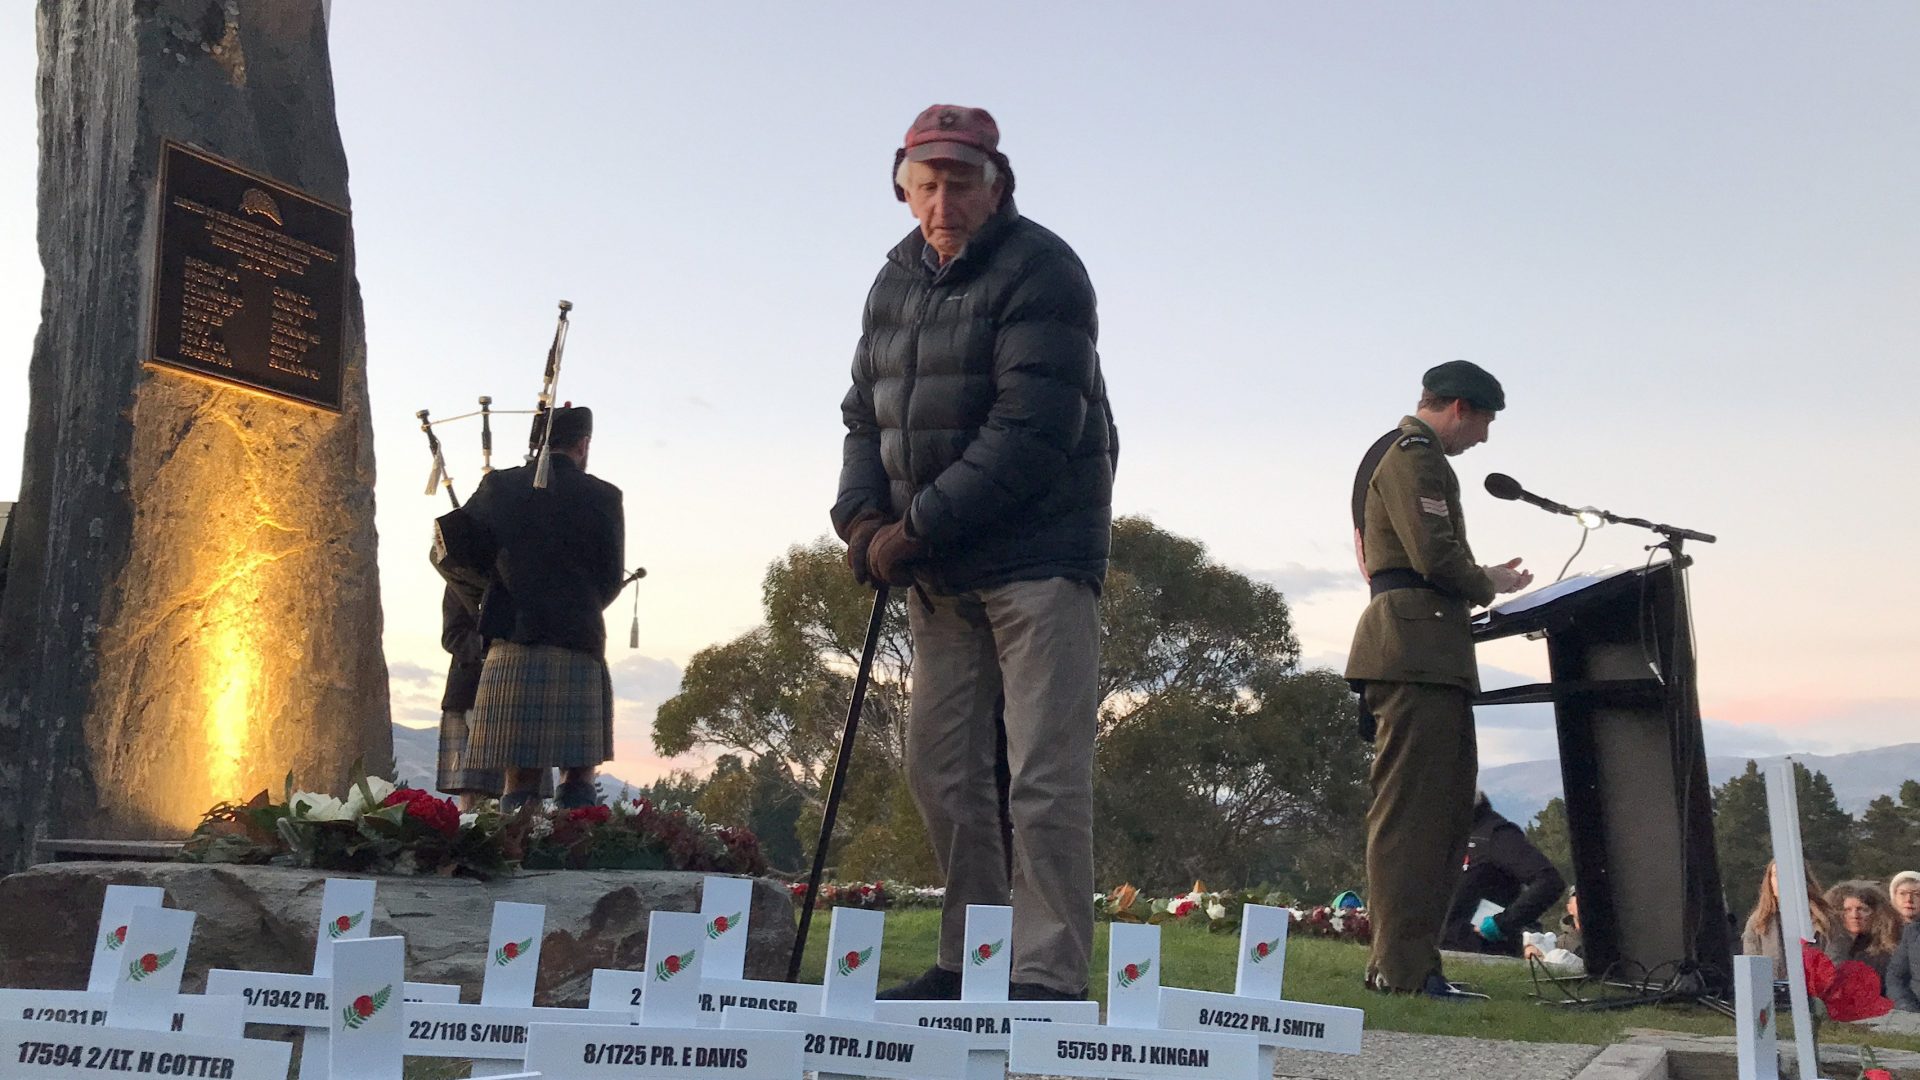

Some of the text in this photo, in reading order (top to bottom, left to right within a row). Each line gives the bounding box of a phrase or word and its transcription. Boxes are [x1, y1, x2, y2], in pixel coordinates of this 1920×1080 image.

[180, 332, 200, 346] FOX
[304, 992, 329, 1010] PR.
[408, 1020, 467, 1042] 22/118
[975, 1017, 998, 1034] PR.
[1001, 1017, 1012, 1034] A
[1199, 1008, 1325, 1038] 8/4222 PR. J SMITH
[18, 1041, 235, 1079] 17594 2/LT. H COTTER
[583, 1043, 748, 1068] 8/1725 PR. E DAVIS
[829, 1036, 862, 1058] TPR.
[864, 1041, 873, 1058] J
[875, 1041, 914, 1062] DOW
[1057, 1040, 1209, 1067] 55759 PR. J KINGAN
